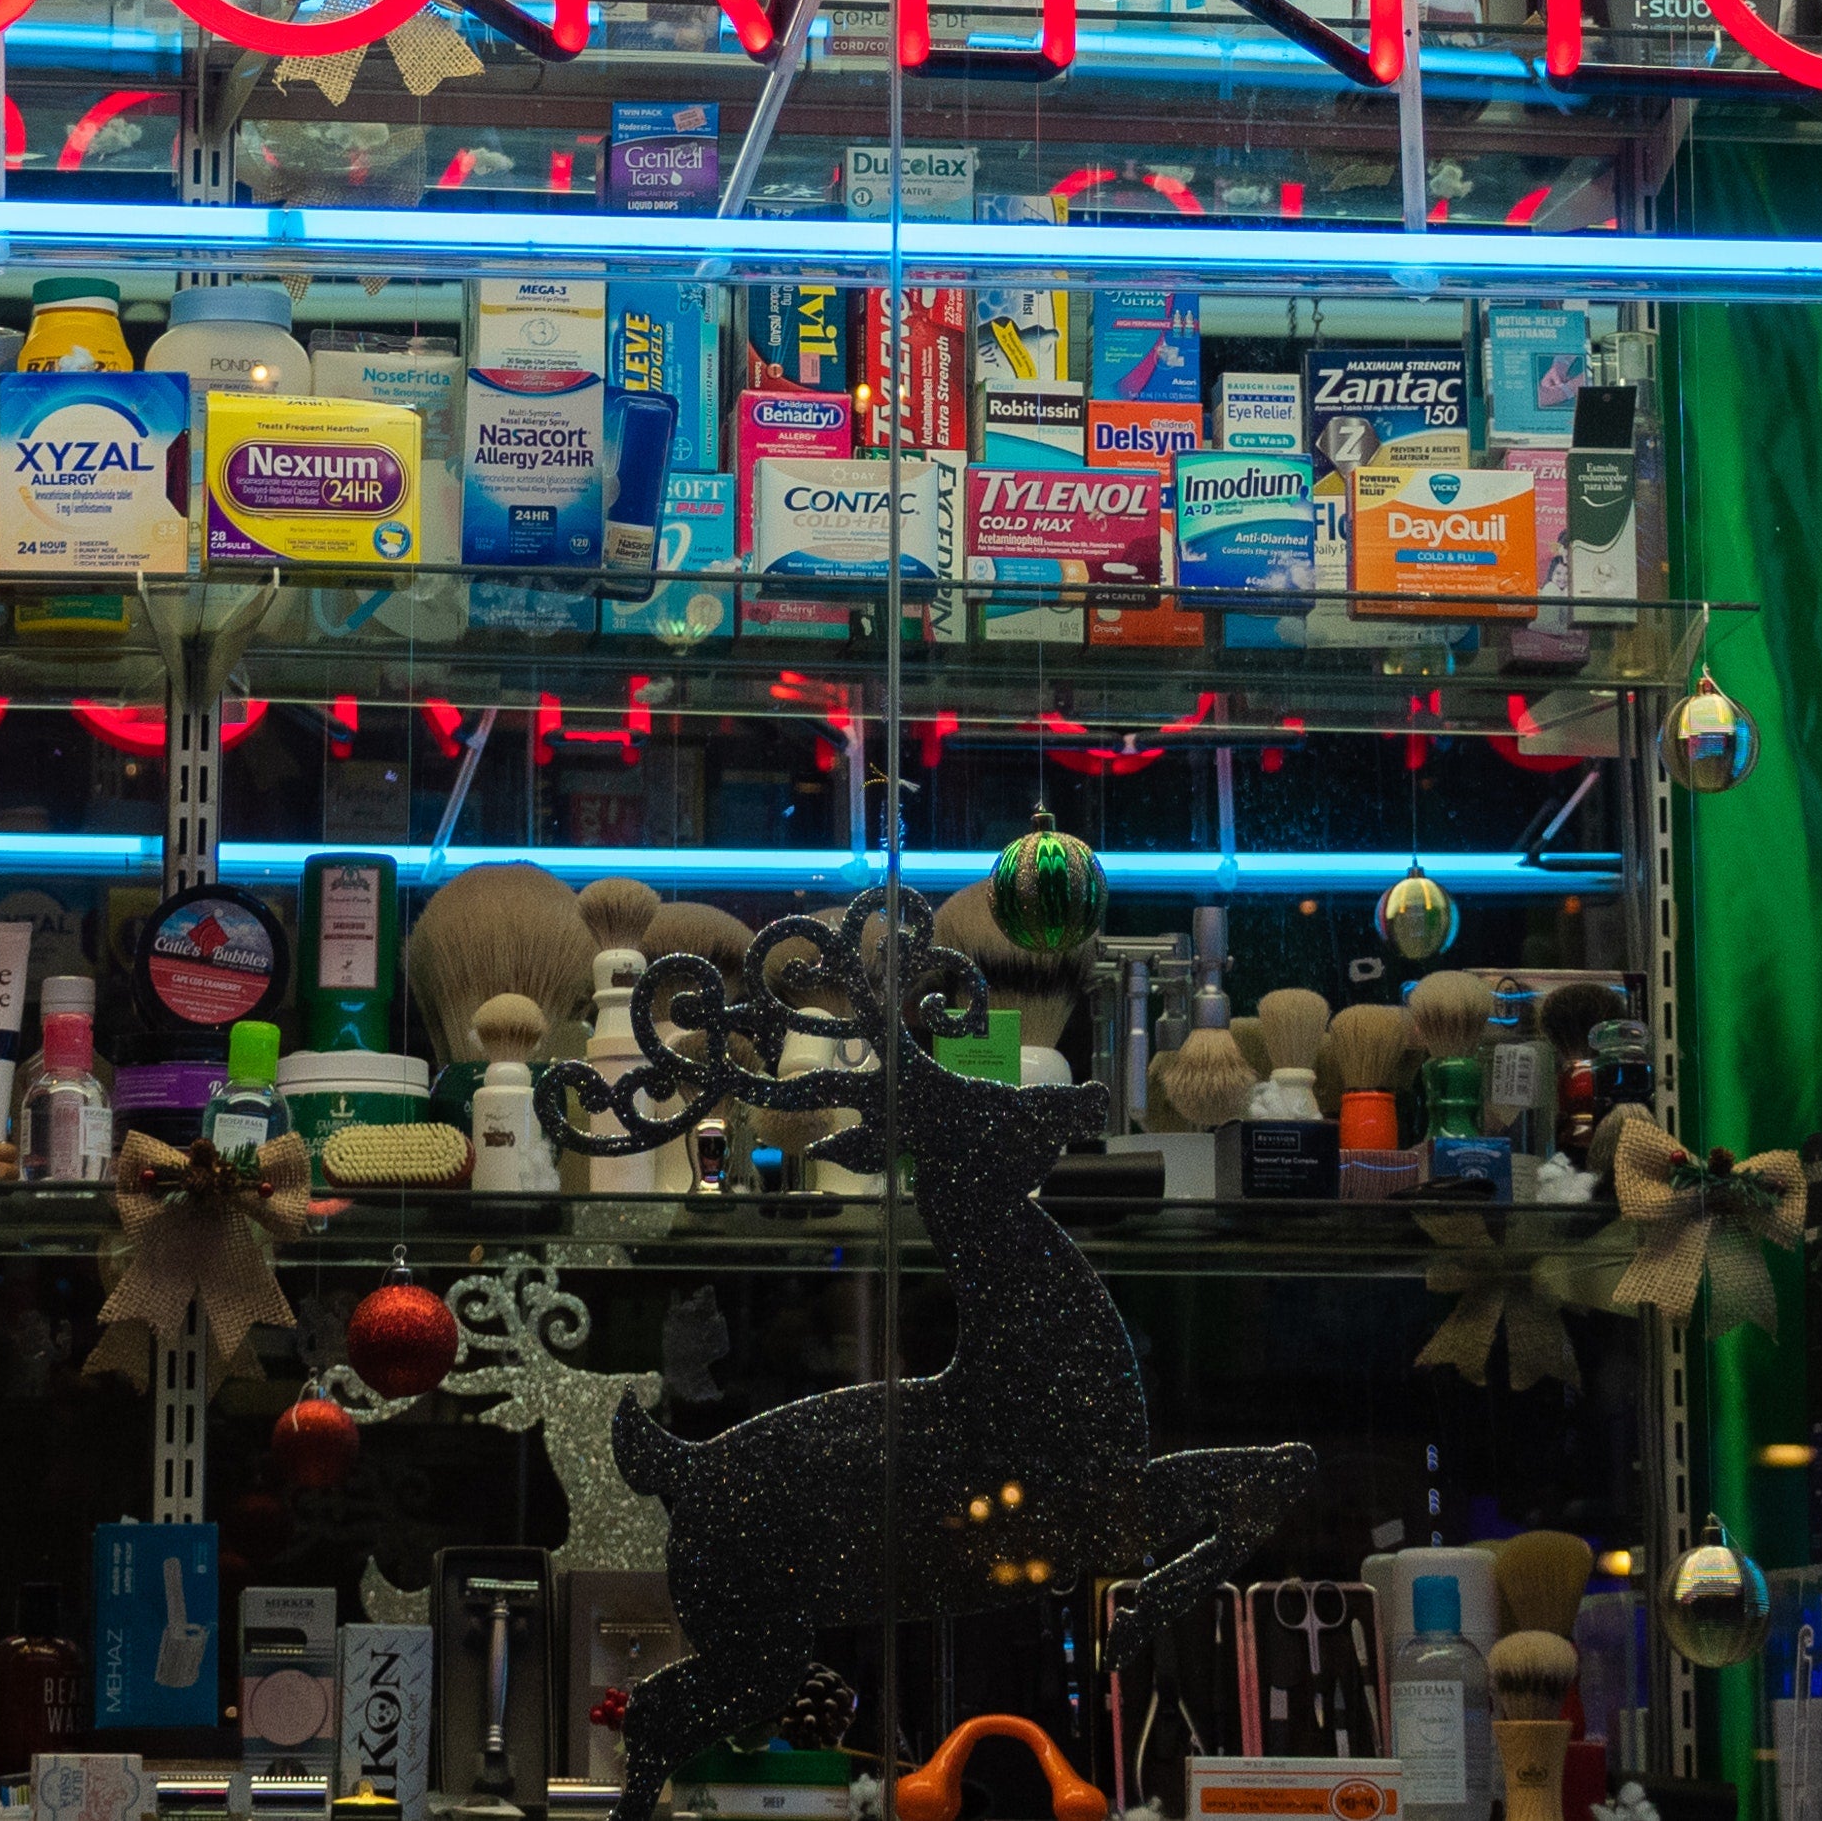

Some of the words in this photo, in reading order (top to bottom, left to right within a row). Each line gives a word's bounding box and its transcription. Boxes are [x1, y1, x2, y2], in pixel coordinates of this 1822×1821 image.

[618, 108, 638, 116] TWIN
[640, 109, 662, 117] PACK
[624, 146, 703, 170] GenTeal
[628, 169, 668, 186] Tears
[628, 201, 655, 210] LIQUID
[657, 201, 678, 210] DROPS
[520, 285, 567, 296] MEGA-3
[1122, 299, 1166, 307] ULTRA
[1495, 316, 1568, 327] MOTION-RELIEF
[1347, 361, 1402, 371] MAXIMUM
[1407, 361, 1461, 371] STRENGTH
[364, 367, 451, 386] NoseFrida
[1315, 369, 1462, 405] Zantac
[1229, 395, 1295, 403] ADVANCED
[508, 409, 562, 419] Multi-Symptom
[990, 398, 1079, 420] Robitussin
[1228, 404, 1252, 420] Eye
[1424, 406, 1458, 426] 150
[500, 416, 520, 426] Nasal
[521, 417, 547, 428] Allergy
[548, 418, 570, 429] Spray
[763, 406, 835, 429] Benadryl
[937, 400, 950, 446] Extra
[257, 422, 283, 432] Treats
[285, 423, 324, 435] Frequent
[325, 424, 370, 434] Heartburn
[480, 424, 589, 448] Nasacort
[779, 432, 817, 441] ALLERGY
[1096, 423, 1196, 456] Delsym
[1235, 435, 1252, 446] Eye
[1256, 435, 1289, 446] Wash
[15, 441, 154, 472] XYZAL
[248, 447, 379, 479] Nexium
[474, 448, 537, 469] Allergy
[541, 450, 594, 468] 24HR
[31, 473, 97, 486] ALLERGY
[1184, 469, 1303, 503] Imodium
[1360, 475, 1401, 484] POWERFUL
[328, 480, 383, 504] 24HR
[978, 471, 1150, 516] TYLENOL
[1360, 489, 1386, 497] RELIEF
[1431, 484, 1459, 493] VICKS
[784, 486, 917, 515] CONTAC
[515, 510, 549, 521] 24HR
[1184, 505, 1212, 517] A-D
[979, 517, 1028, 531] COLD
[1033, 518, 1073, 533] MAX
[1388, 513, 1507, 547] DayQuil
[211, 530, 227, 542] 28
[978, 533, 1043, 547] Acetaminophen
[1235, 532, 1308, 546] Anti-Diarrheal
[18, 541, 37, 555] 24
[39, 541, 67, 549] HOUR
[211, 542, 251, 550] CAPSULES
[1417, 552, 1441, 562] COLD
[1443, 552, 1451, 562] &
[1454, 553, 1476, 563] FLU
[154, 935, 201, 958] Catie's
[211, 944, 270, 970] Bubbles
[106, 1628, 124, 1713] MEHAZ
